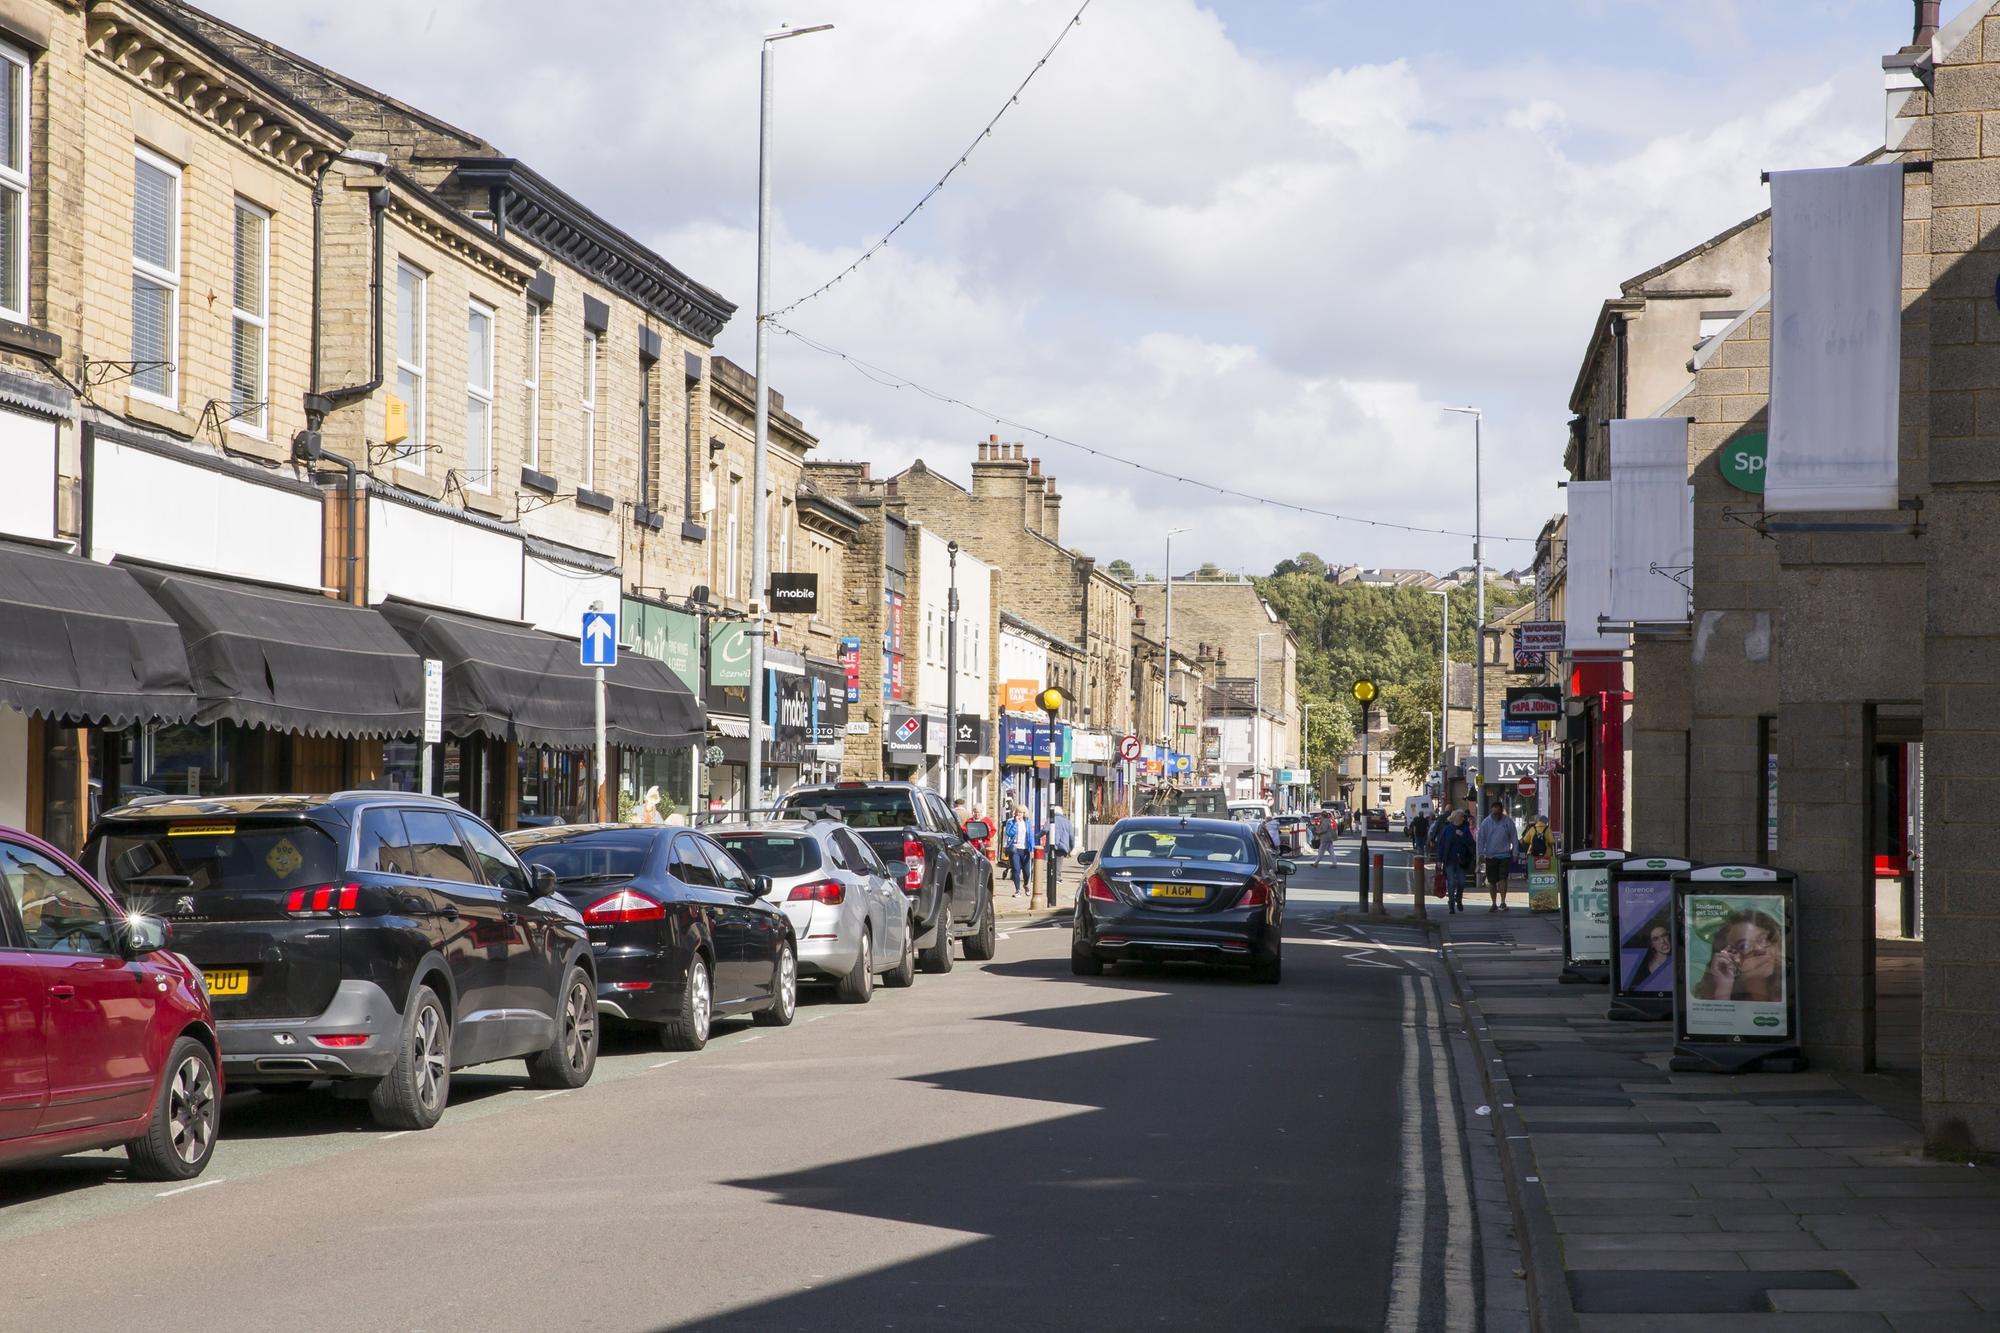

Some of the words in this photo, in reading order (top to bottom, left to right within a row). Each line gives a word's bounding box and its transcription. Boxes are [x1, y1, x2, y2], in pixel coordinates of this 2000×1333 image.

[776, 588, 815, 599] imobile
[781, 687, 809, 727] imobile
[1511, 701, 1530, 712] PAPA
[1531, 701, 1556, 712] JOHN'S
[890, 742, 923, 750] Domino's
[1531, 877, 1556, 885] £9.99
[1172, 886, 1193, 896] AGM
[1570, 885, 1609, 912] fre
